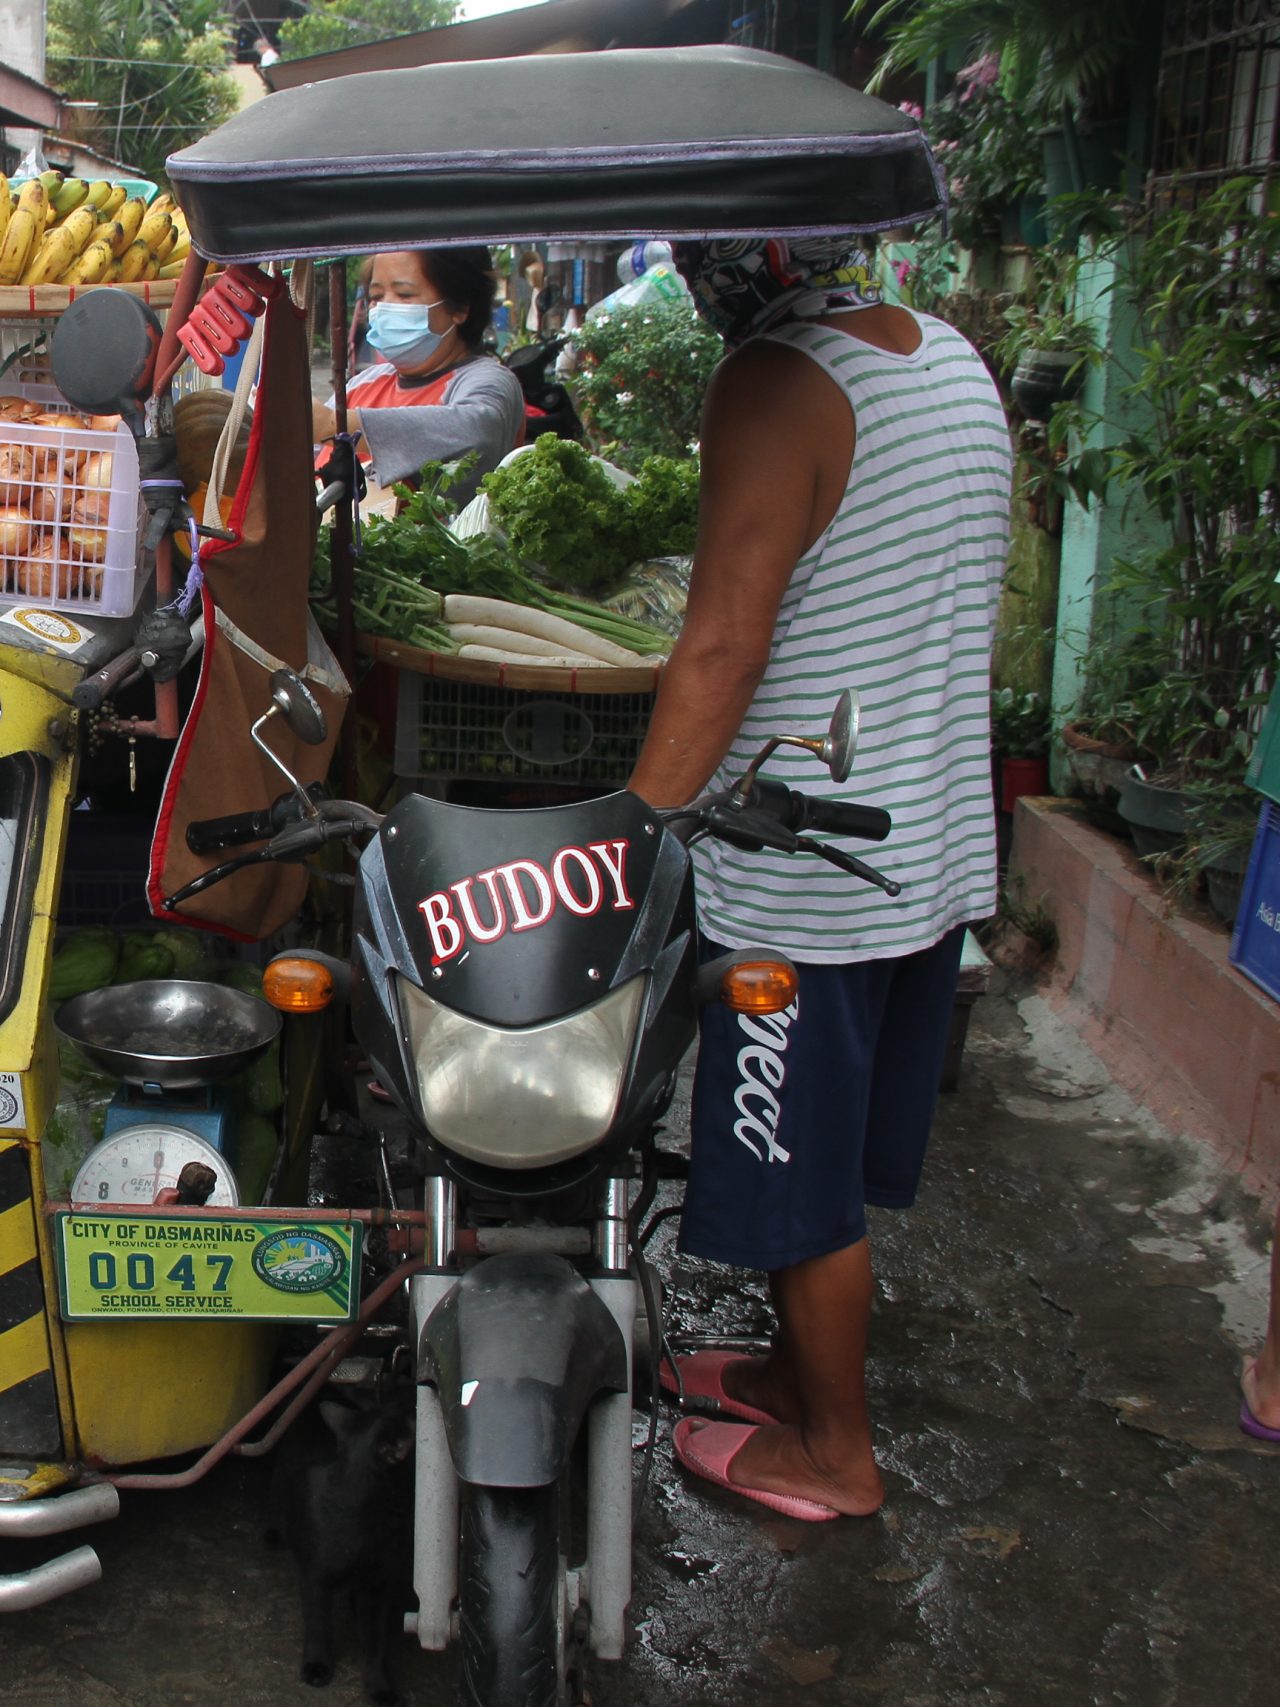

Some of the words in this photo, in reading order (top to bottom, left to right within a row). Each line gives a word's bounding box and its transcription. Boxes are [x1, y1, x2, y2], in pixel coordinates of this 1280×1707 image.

[417, 840, 632, 962] BUDOY
[98, 1182, 109, 1200] 8
[72, 1223, 110, 1238] CITY
[117, 1224, 139, 1239] OF
[145, 1225, 255, 1242] DASMARIÑAS
[256, 1234, 284, 1257] LUNGSOD
[89, 1252, 234, 1291] 0047
[101, 1295, 160, 1307] SCHOOL
[165, 1296, 233, 1307] SERVICE
